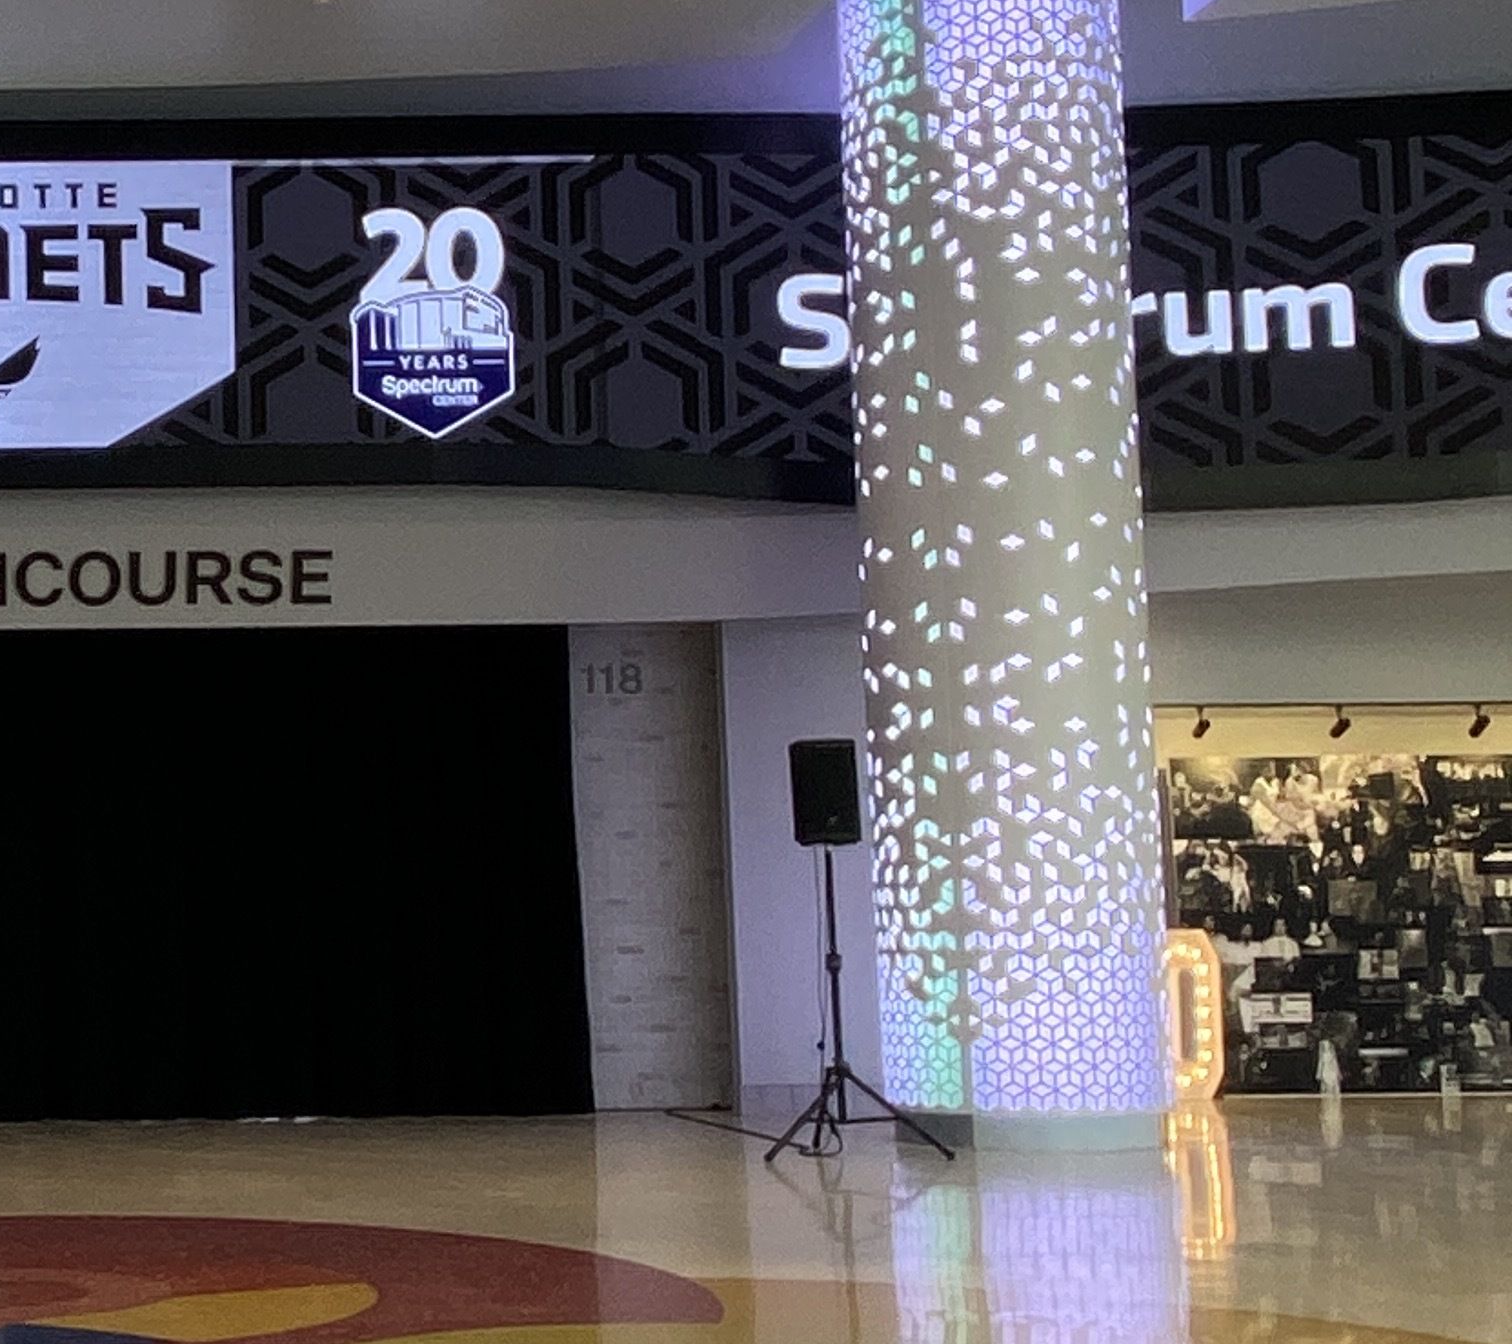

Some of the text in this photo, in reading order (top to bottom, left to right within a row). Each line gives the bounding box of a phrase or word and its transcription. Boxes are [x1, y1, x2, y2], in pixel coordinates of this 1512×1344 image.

[361, 207, 505, 304] 20
[398, 354, 469, 371] YEARS
[381, 374, 478, 400] Spectrum
[580, 661, 643, 694] 118
